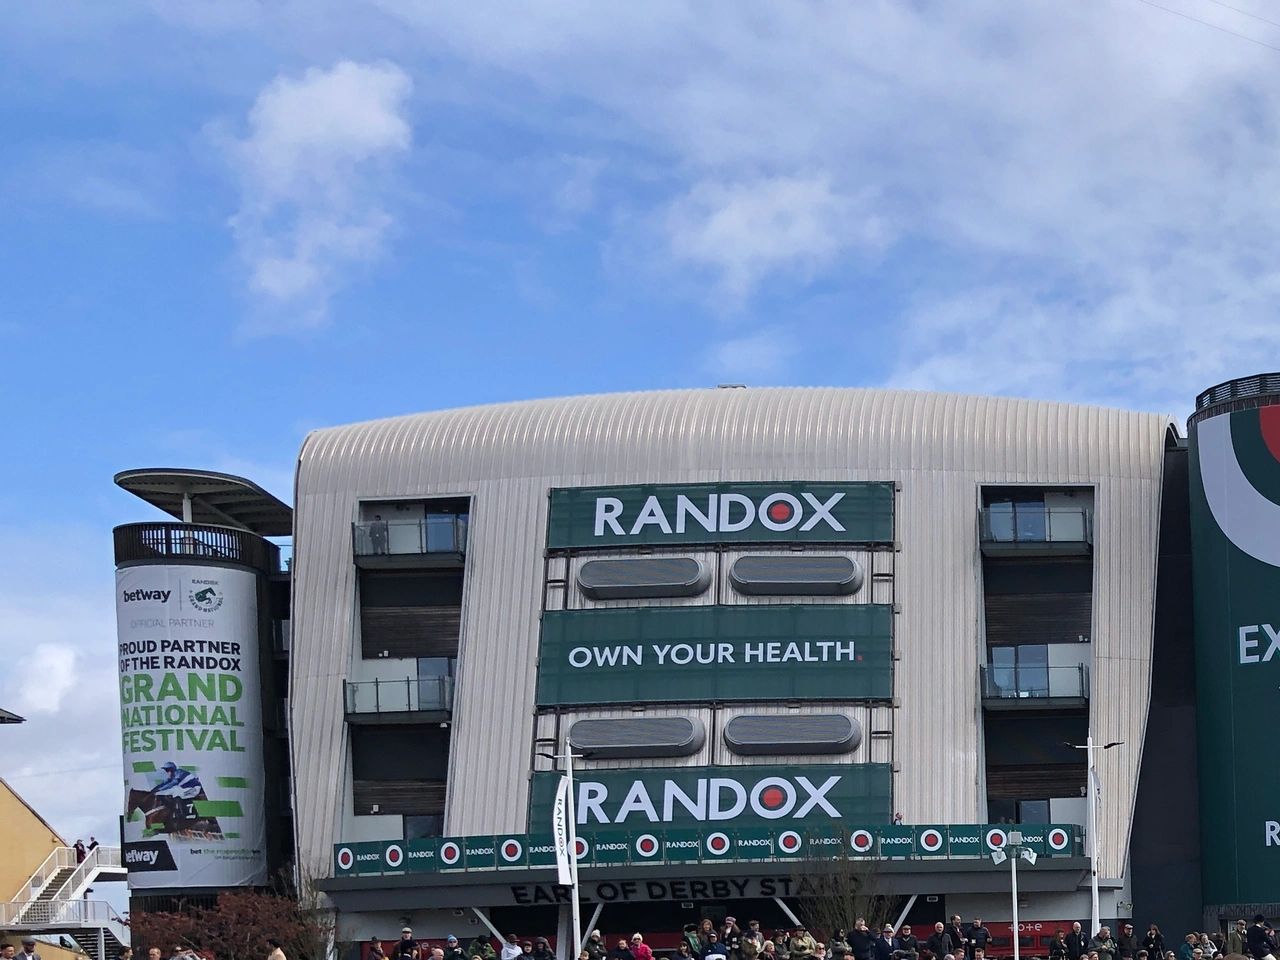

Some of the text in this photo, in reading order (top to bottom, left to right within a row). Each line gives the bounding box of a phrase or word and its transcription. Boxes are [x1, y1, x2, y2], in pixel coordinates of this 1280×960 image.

[593, 490, 847, 537] RANDOX
[123, 589, 172, 603] betway
[168, 618, 215, 629] PARTNER
[160, 639, 241, 656] PARTNER
[568, 644, 644, 668] OWN
[652, 641, 735, 666] YOUR
[120, 655, 242, 673] OF THE RANDOX
[121, 672, 243, 704] GRAND
[122, 704, 245, 728] NATIONAL
[123, 728, 246, 754] FESTIVAL
[577, 775, 843, 825] RANDOX
[556, 798, 567, 857] RANDOX
[666, 840, 699, 849] RANDOX
[738, 838, 771, 847] RANDOX
[809, 837, 842, 846] RANDOX
[881, 836, 913, 845] RANDOX
[949, 835, 980, 844] RANDOX
[1021, 835, 1044, 843] ANDOX
[465, 847, 495, 856] RANDOX
[529, 845, 556, 854] RANDO
[596, 842, 628, 851] RANDOX
[356, 853, 380, 862] RANDOX
[408, 850, 435, 859] RANDOX
[596, 880, 637, 901] OF
[646, 878, 750, 900] DERBY
